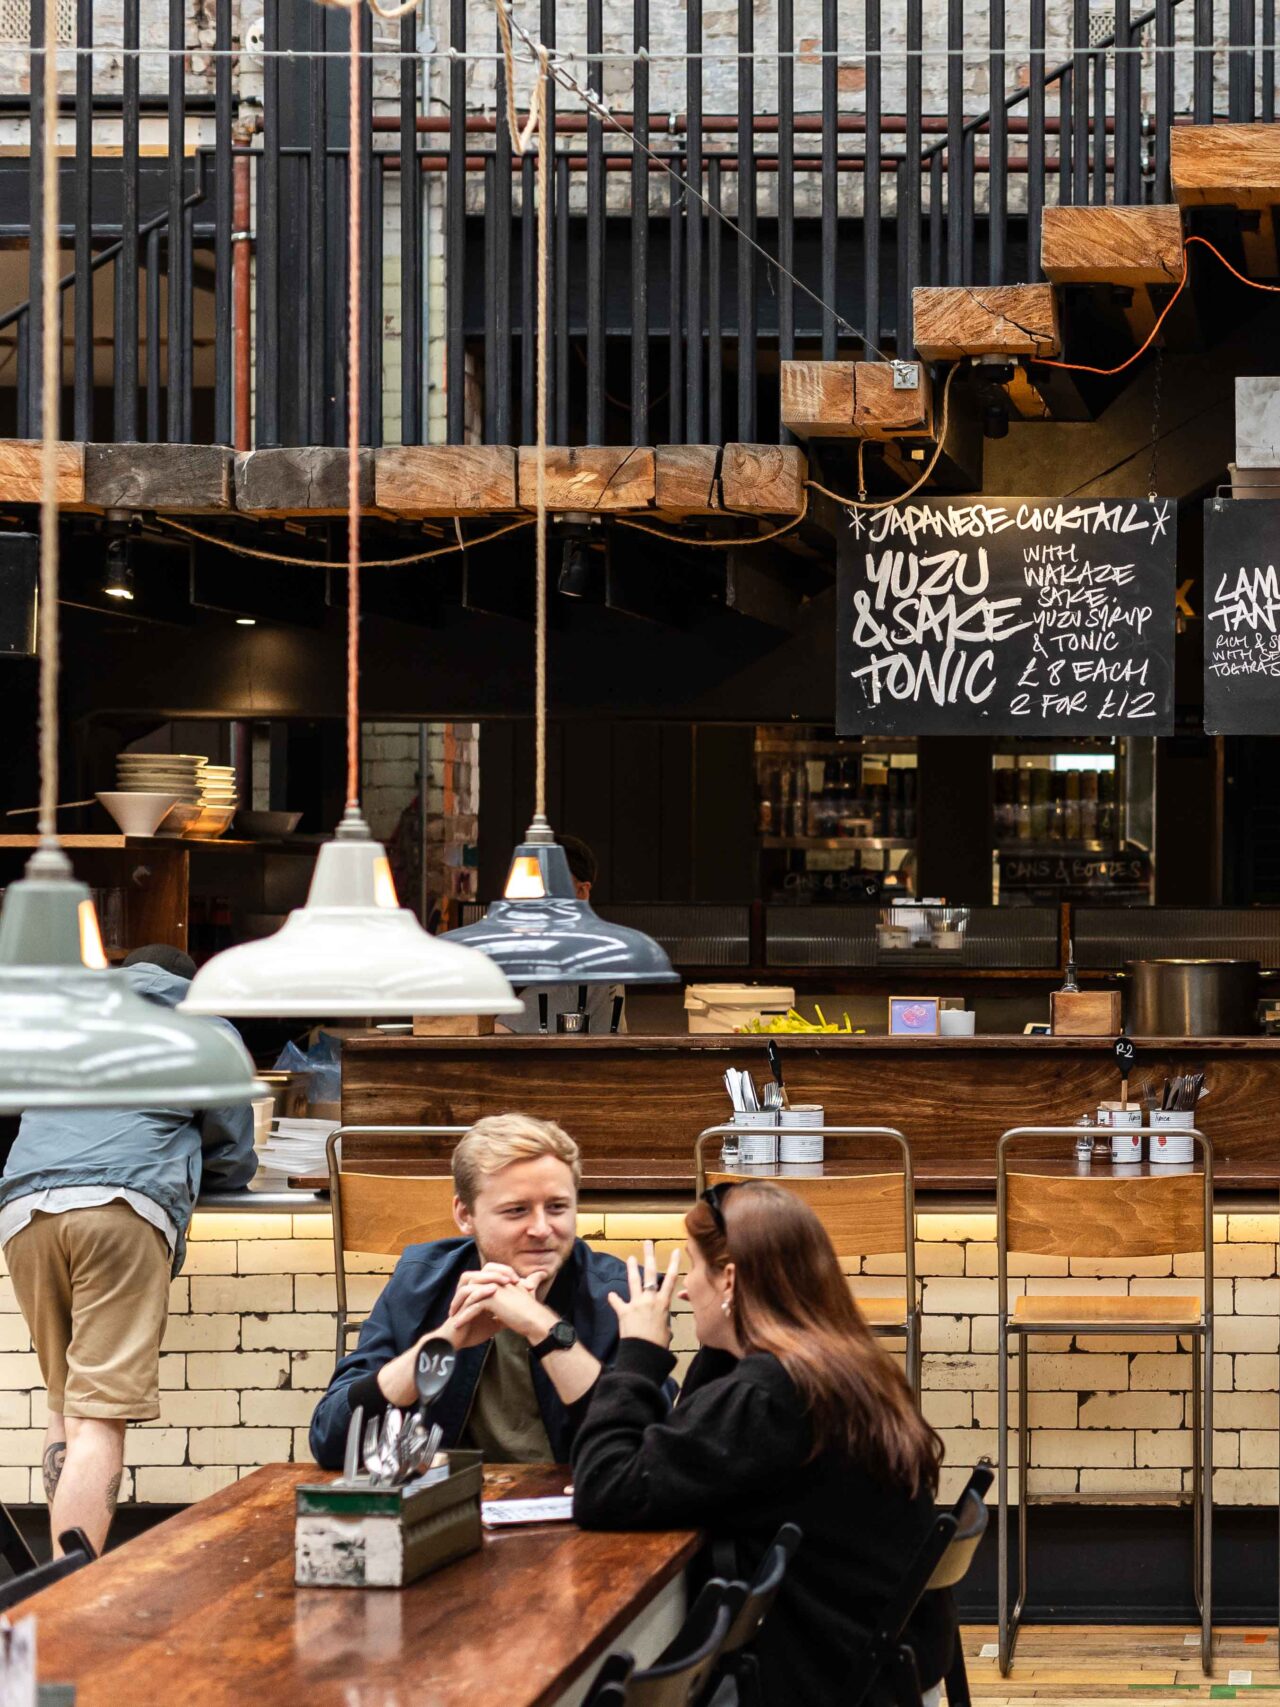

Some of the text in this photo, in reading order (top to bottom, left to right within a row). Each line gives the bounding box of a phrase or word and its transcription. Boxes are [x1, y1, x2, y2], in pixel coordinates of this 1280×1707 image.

[869, 502, 1150, 545] JAPANESE COCKTAIL
[1023, 544, 1079, 564] WITH
[865, 547, 990, 610] YUZU
[1023, 563, 1136, 587] WAKAZE
[853, 590, 1033, 651] & SAKE
[1032, 607, 1153, 636] YUZU SYRUP
[1032, 631, 1120, 658] & TONIC
[1212, 649, 1253, 661] WITH
[1216, 634, 1249, 649] RICH
[1254, 632, 1266, 650] &
[852, 650, 997, 707] TONIC
[1073, 658, 1150, 687] EACH
[1009, 689, 1157, 720] 2 FOR £12
[1073, 859, 1142, 879] BOTLES
[1115, 1042, 1134, 1059] R2
